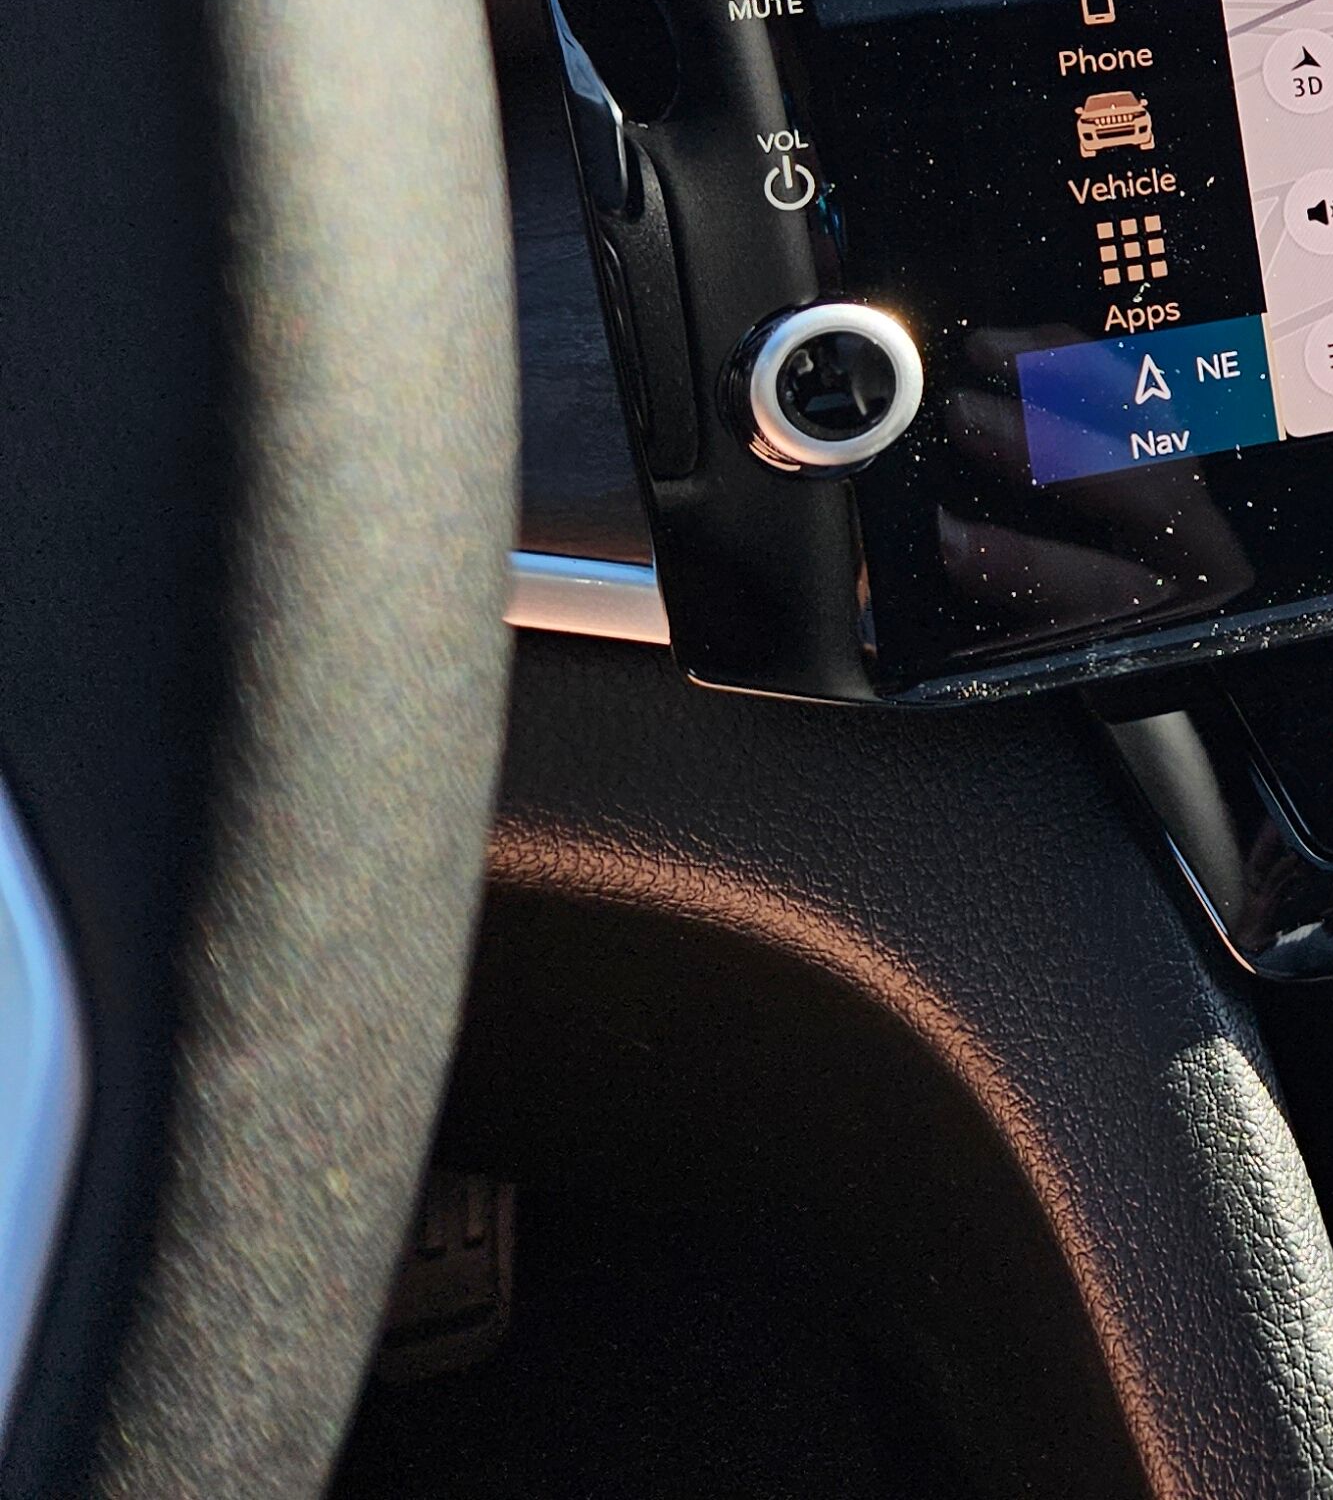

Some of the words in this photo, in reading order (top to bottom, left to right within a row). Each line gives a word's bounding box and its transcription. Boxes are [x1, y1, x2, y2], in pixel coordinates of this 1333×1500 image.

[1058, 47, 1154, 77] Phone
[1291, 75, 1324, 98] 3D
[756, 129, 810, 154] VOL
[1067, 167, 1177, 205] Vehicle
[1104, 301, 1181, 334] Apps
[1195, 350, 1242, 383] NE
[1130, 429, 1191, 460] Nav
